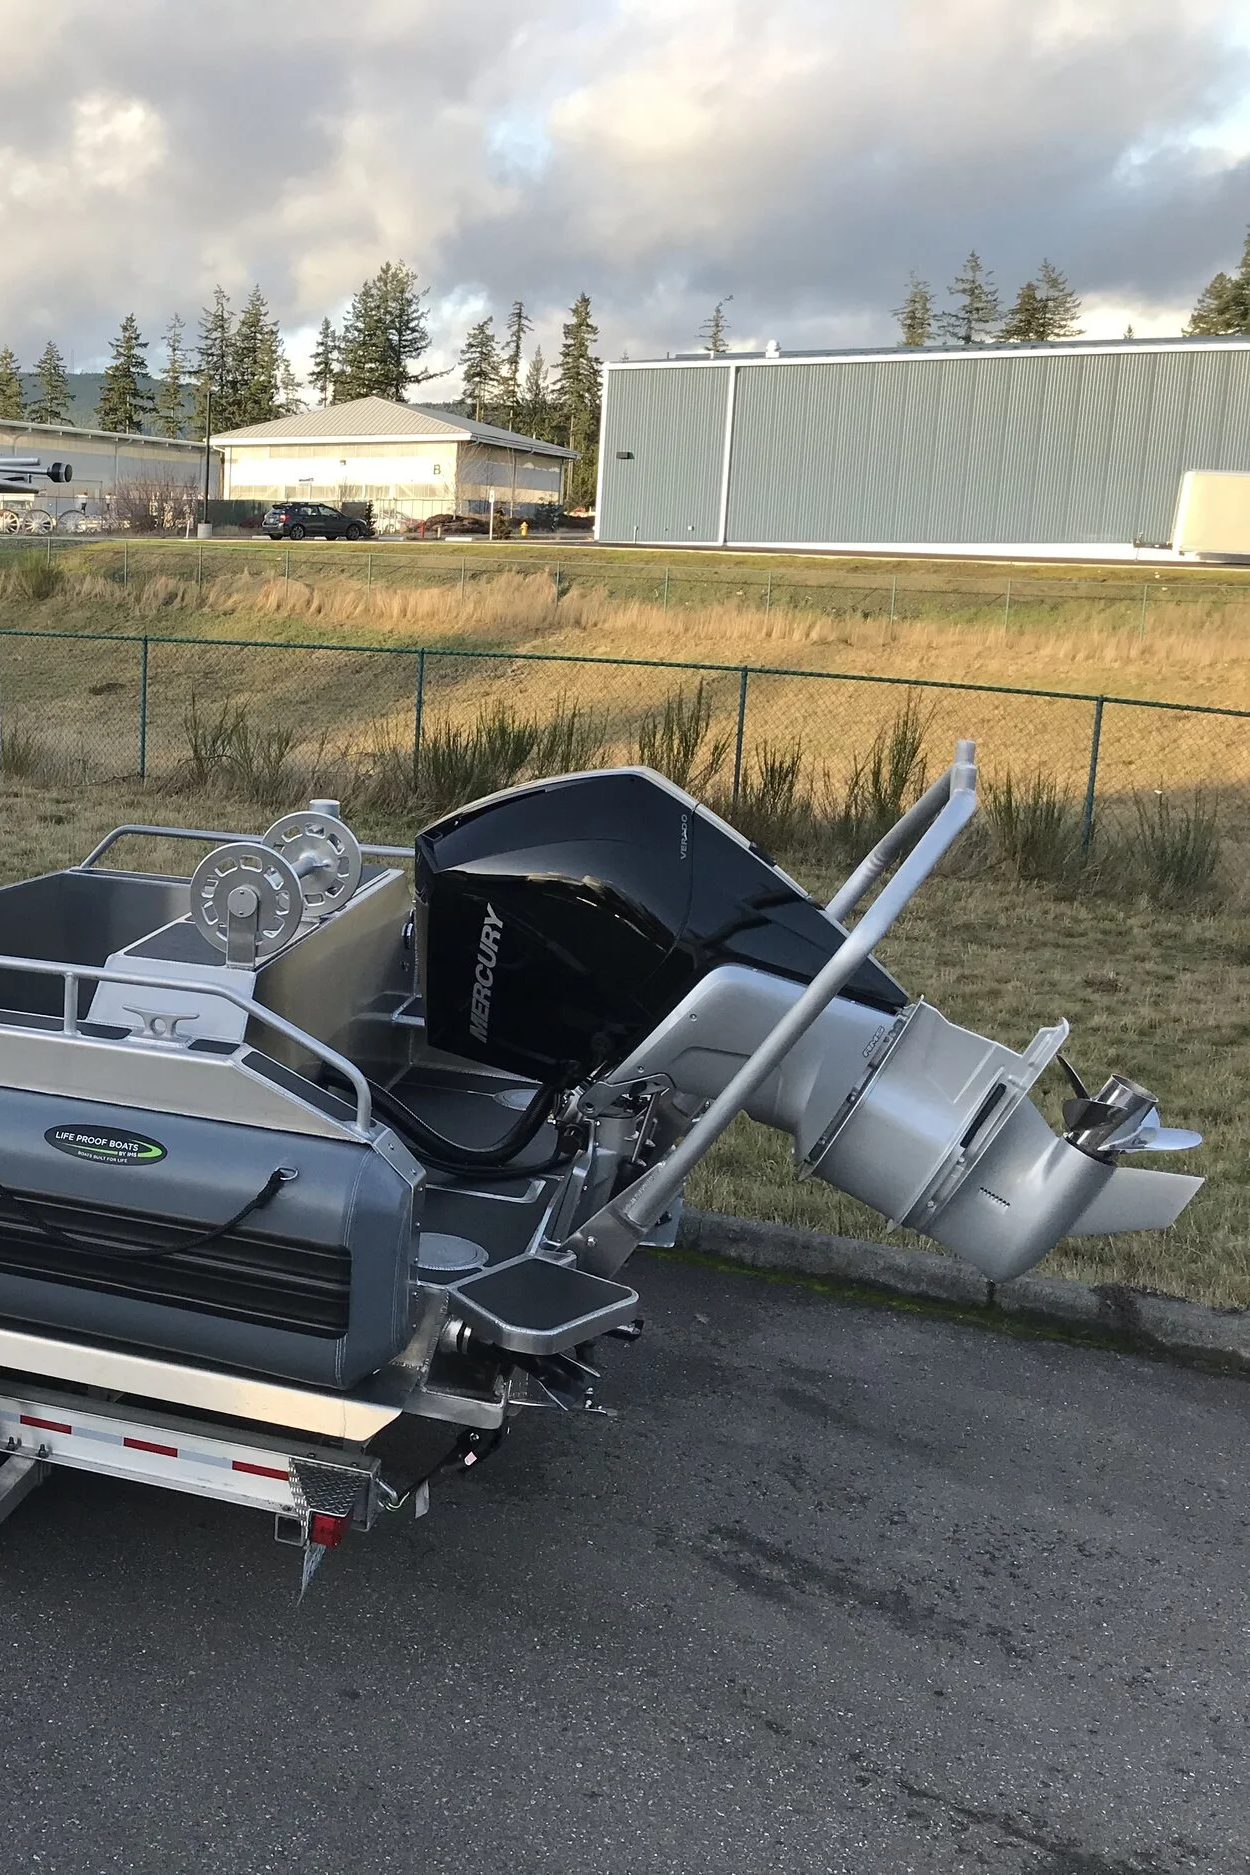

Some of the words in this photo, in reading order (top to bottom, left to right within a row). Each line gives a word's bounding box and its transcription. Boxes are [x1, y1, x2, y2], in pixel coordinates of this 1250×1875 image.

[433, 464, 441, 475] B
[680, 814, 688, 860] VERADO
[469, 902, 504, 1044] MERCURY
[55, 1131, 75, 1141] LIFE
[76, 1134, 108, 1146] PROOF
[109, 1140, 139, 1152] BOATS
[77, 1150, 92, 1158] BOATS
[93, 1153, 107, 1161] BUILT
